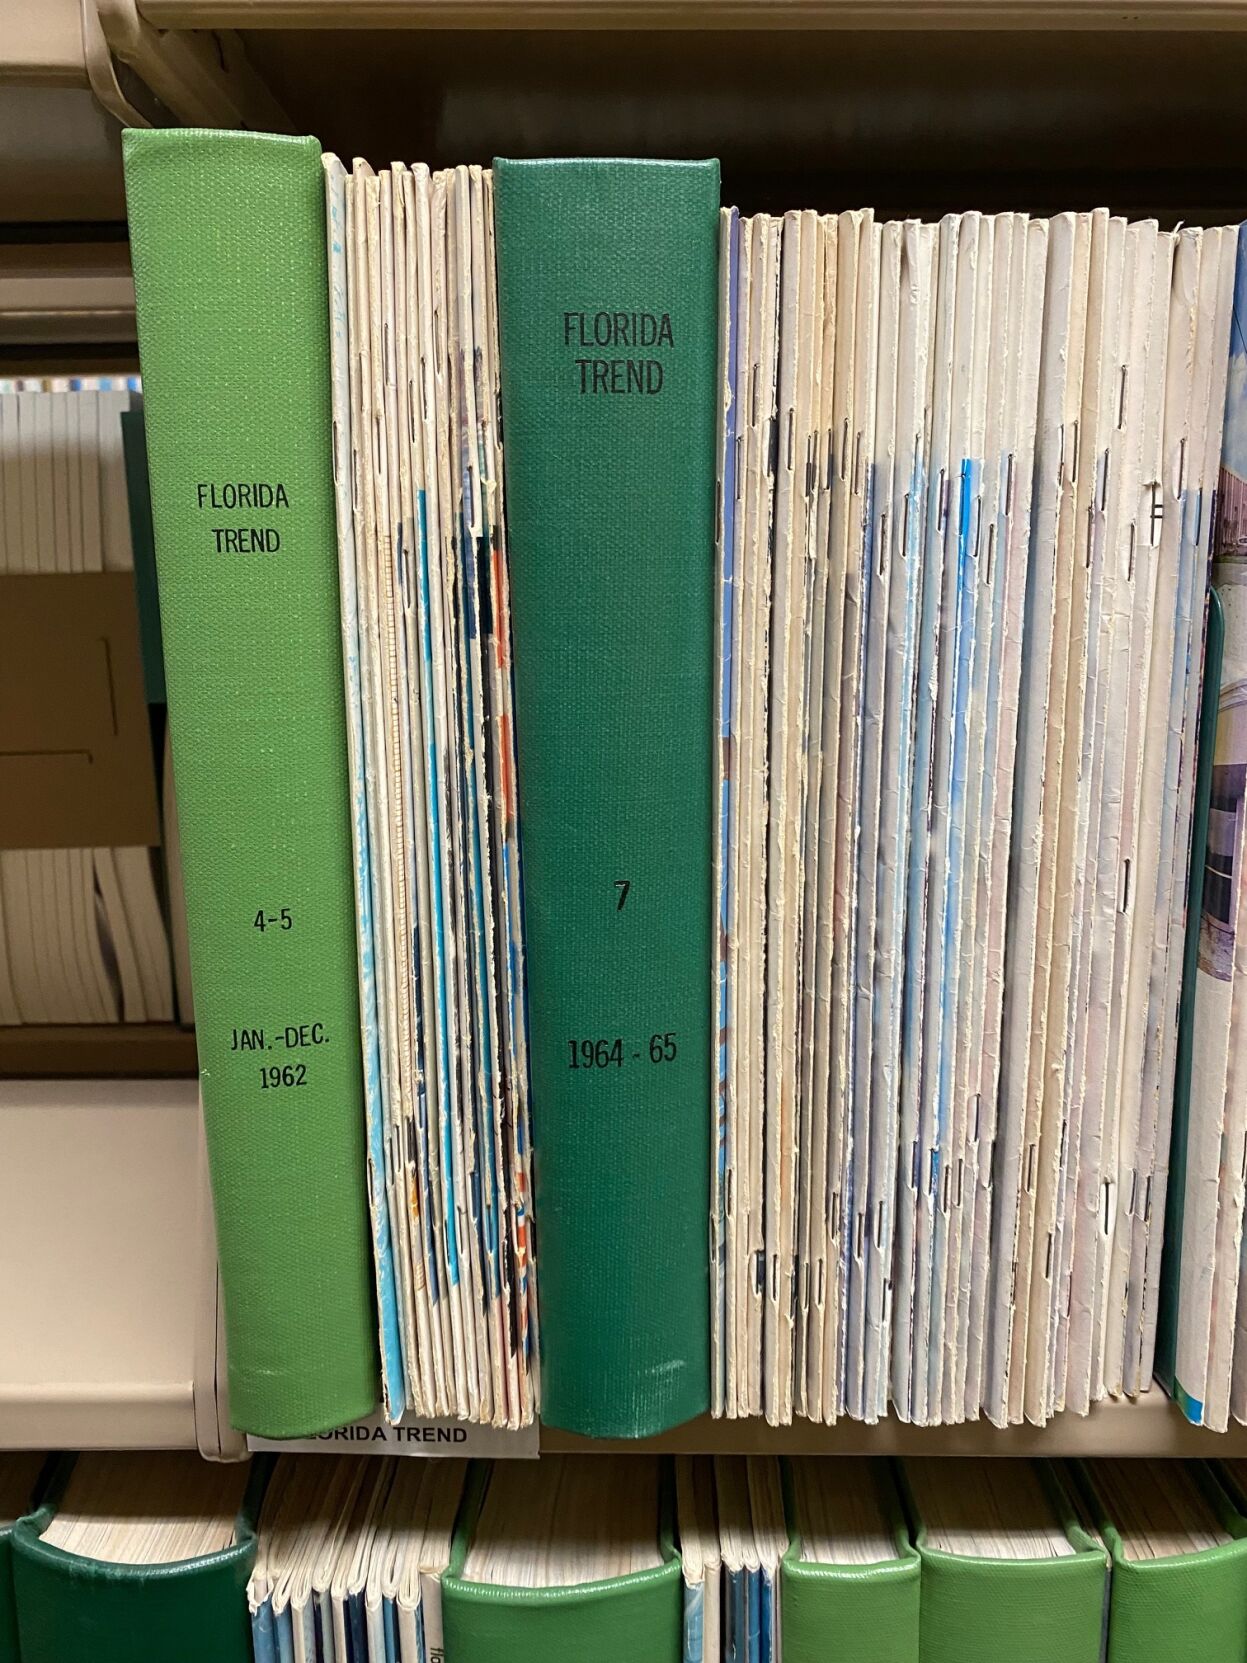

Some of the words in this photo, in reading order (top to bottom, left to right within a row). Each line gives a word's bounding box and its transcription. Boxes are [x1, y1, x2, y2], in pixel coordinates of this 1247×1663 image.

[563, 311, 675, 348] FLORIDA
[575, 359, 664, 394] TREND
[197, 483, 290, 509] FLORIDA
[211, 528, 281, 553] TREND
[613, 880, 630, 912] 7
[254, 908, 293, 932] 4-5
[231, 1022, 330, 1051] JAN.-DEC.
[568, 1038, 624, 1069] 1964
[649, 1032, 677, 1063] 65
[259, 1064, 308, 1089] 1962
[308, 1425, 387, 1441] ORIDA
[393, 1427, 467, 1443] TREND
